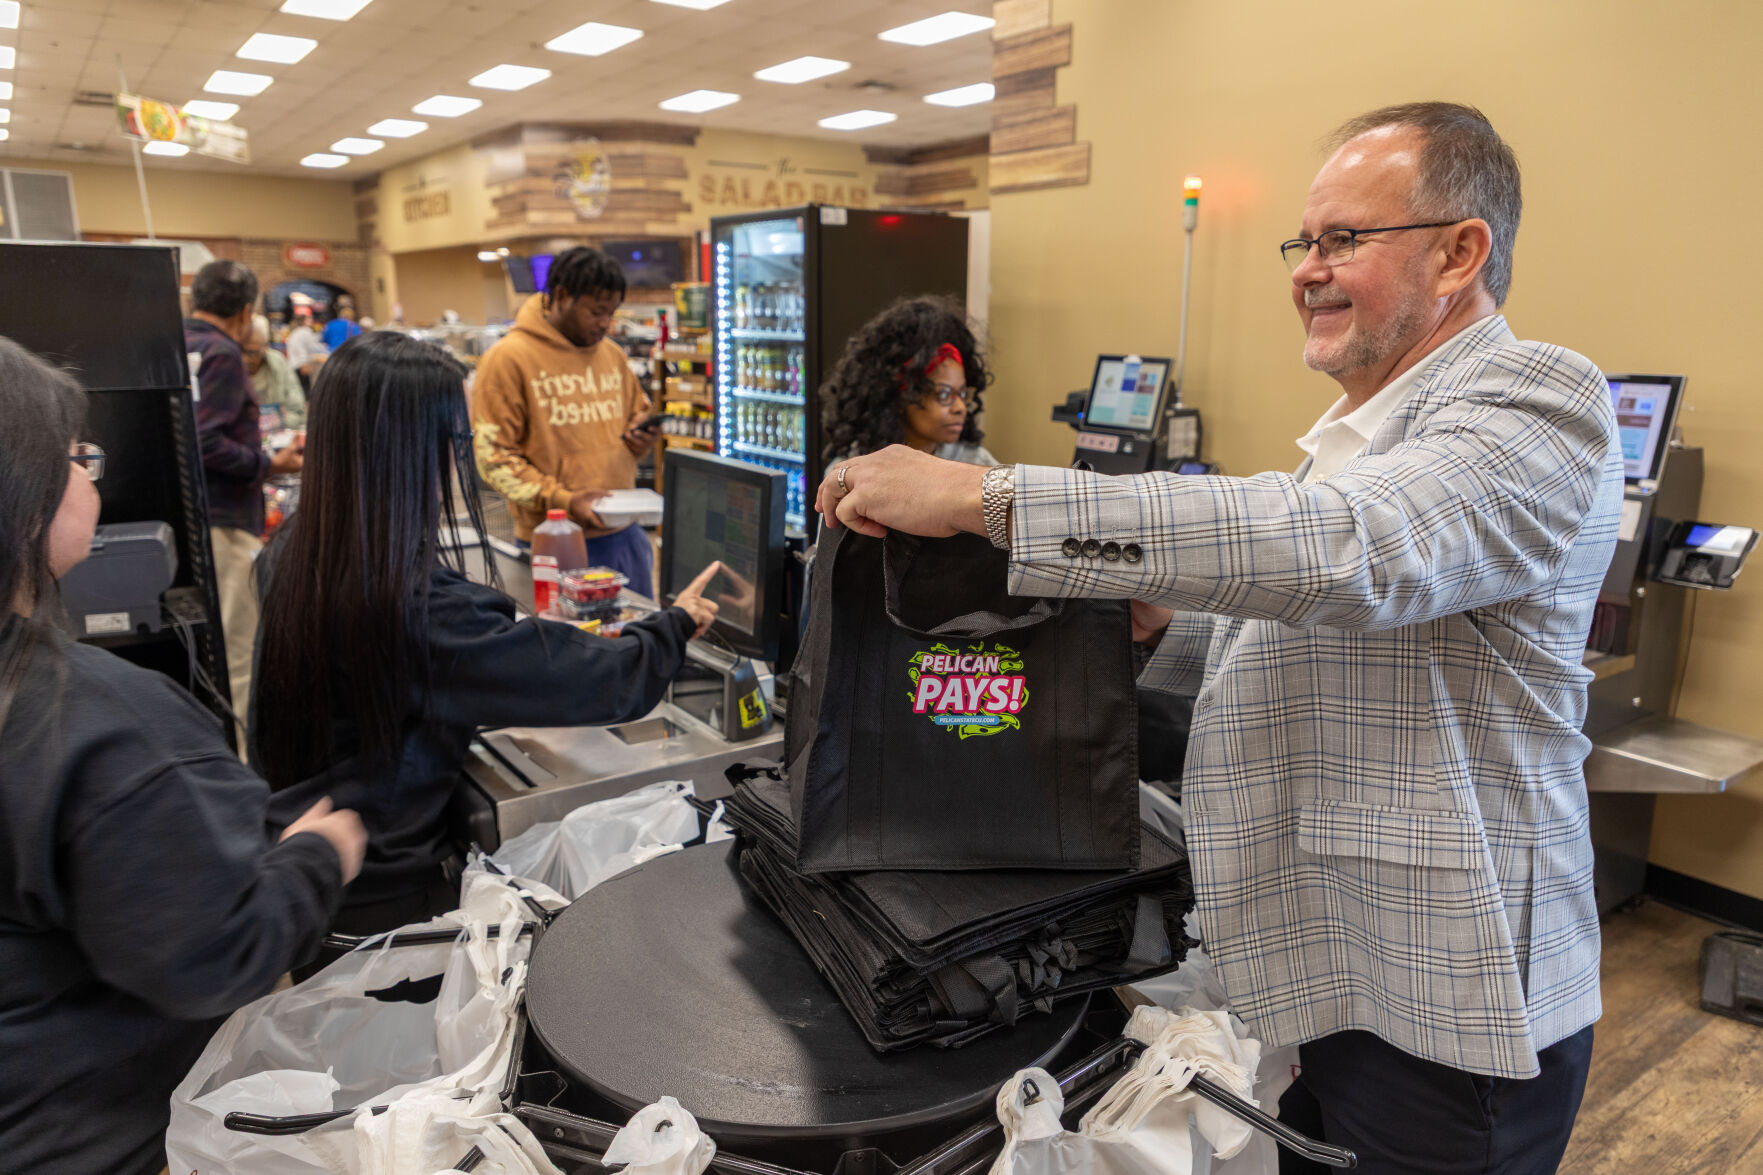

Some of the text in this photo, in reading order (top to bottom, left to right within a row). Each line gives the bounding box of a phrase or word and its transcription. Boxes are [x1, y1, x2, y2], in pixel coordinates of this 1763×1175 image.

[700, 174, 868, 207] SALAD BAR
[920, 655, 999, 672] PELICAN
[913, 675, 1025, 713] PAYS!
